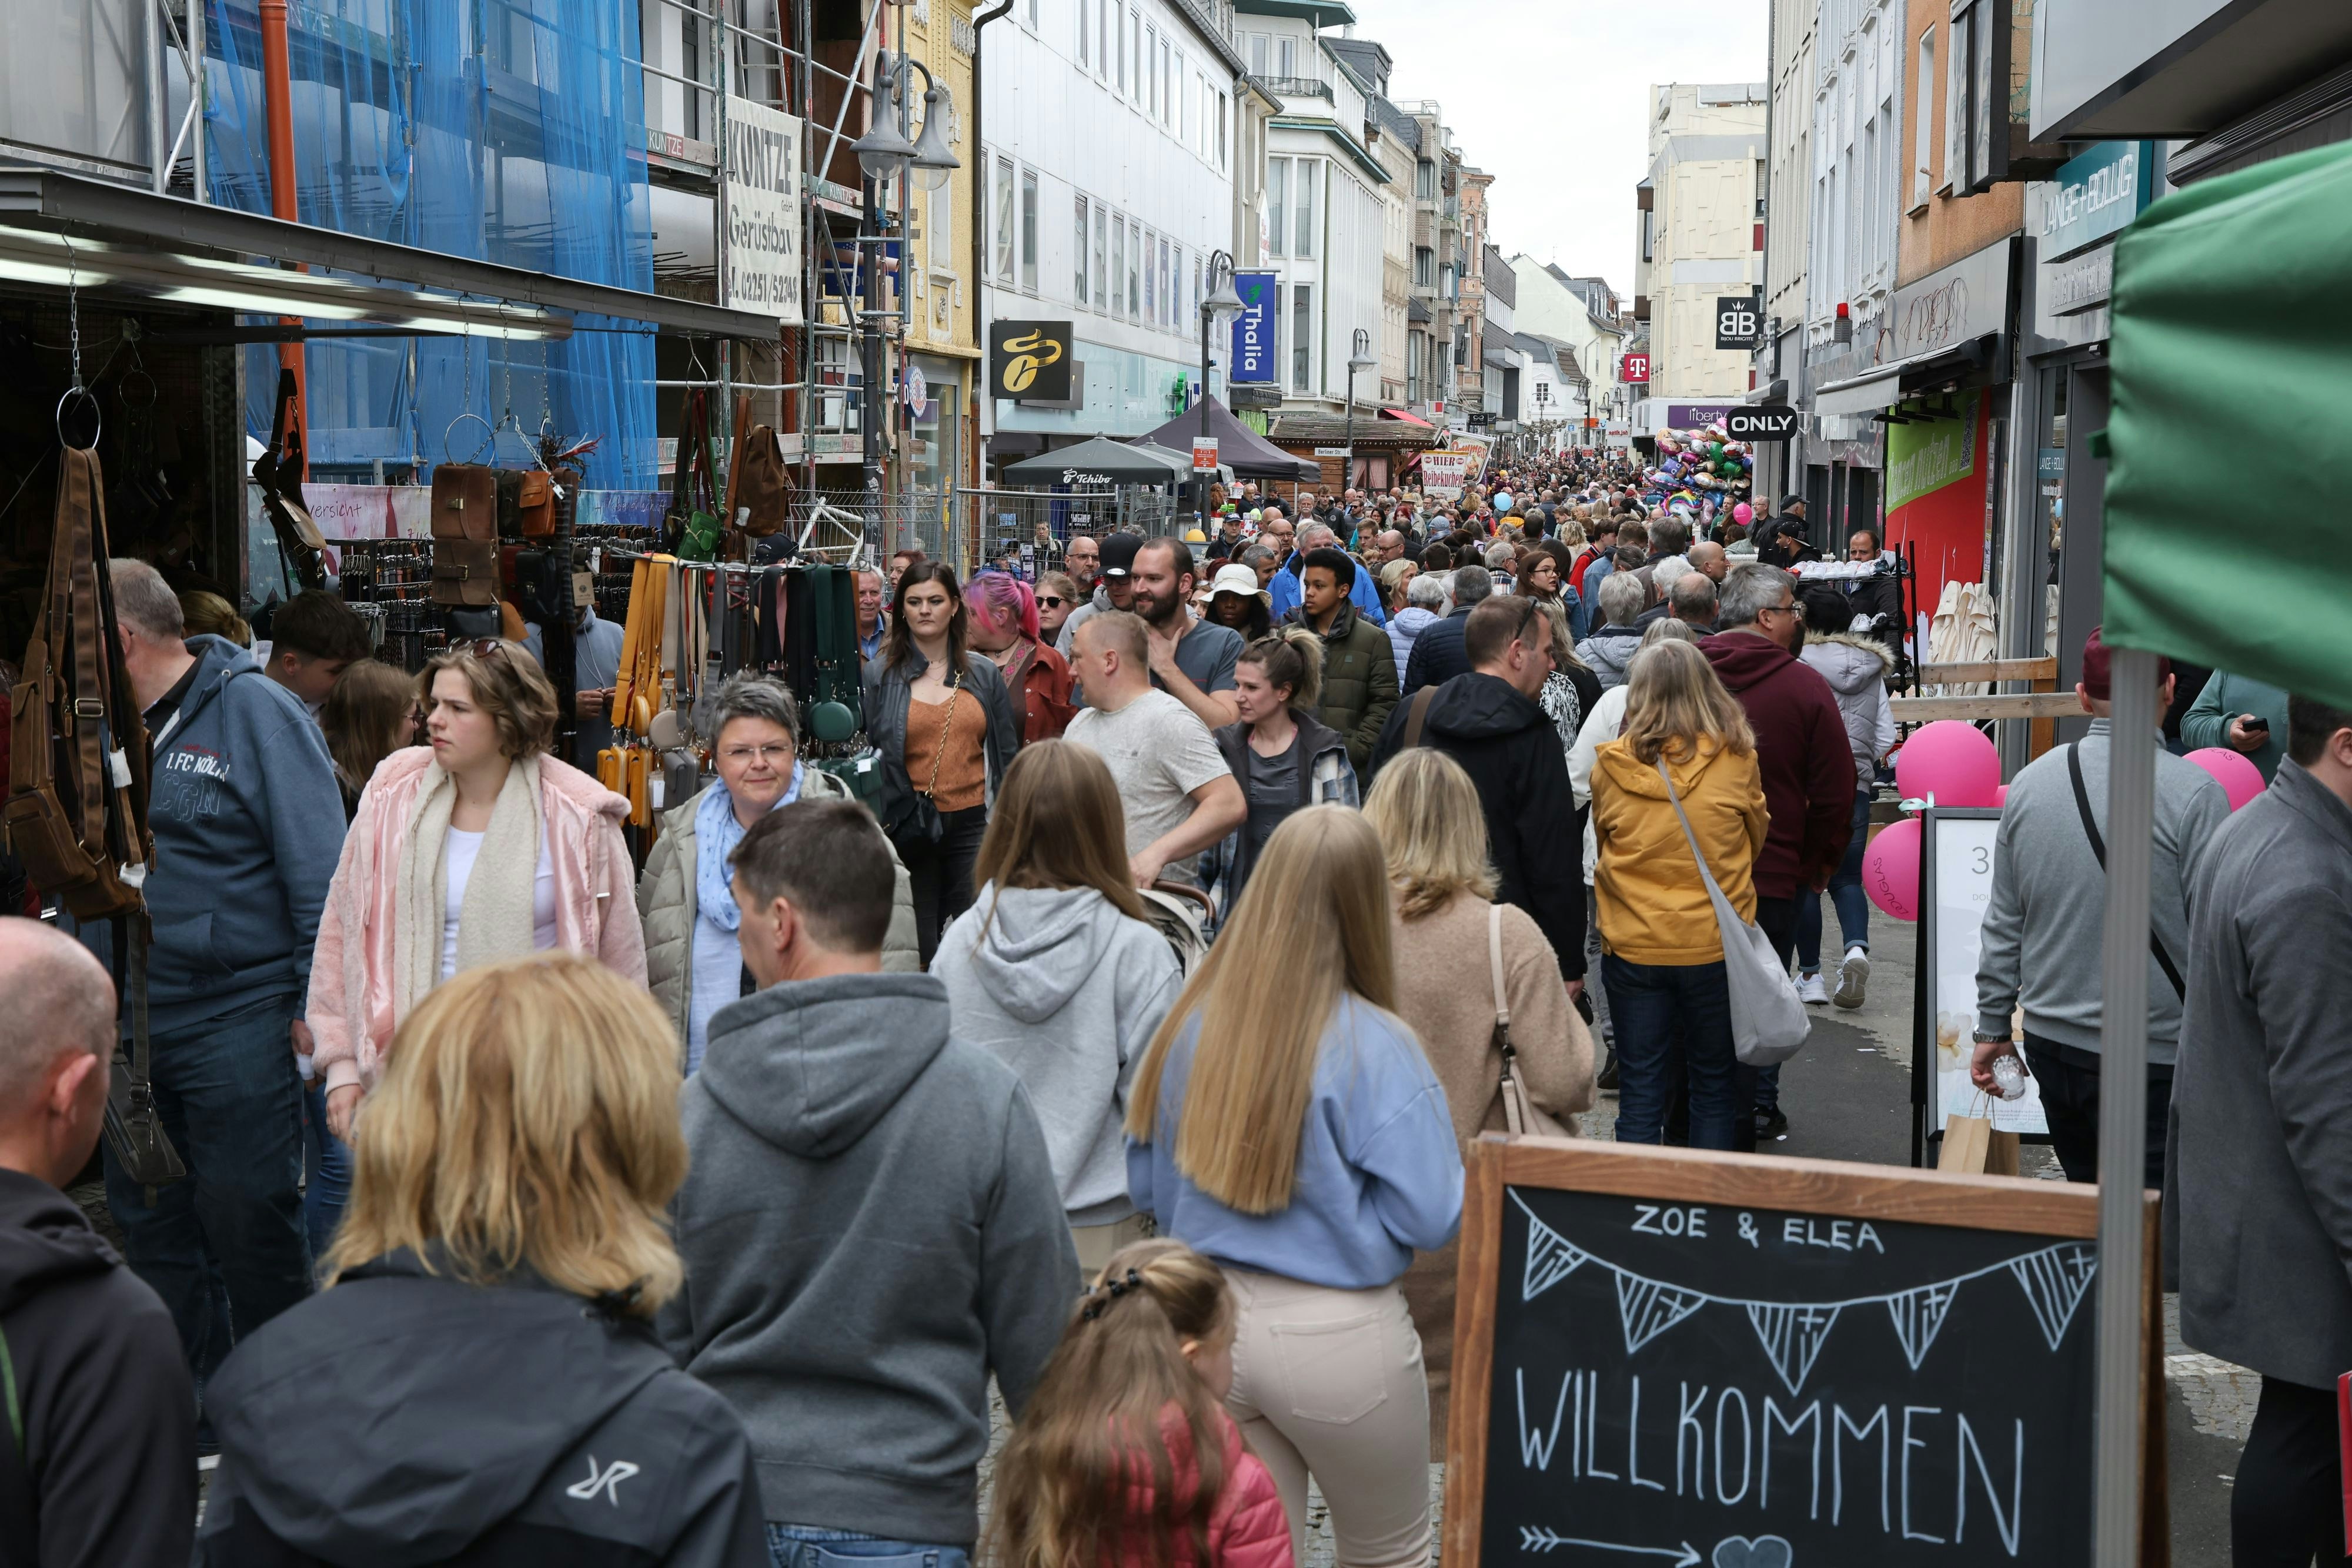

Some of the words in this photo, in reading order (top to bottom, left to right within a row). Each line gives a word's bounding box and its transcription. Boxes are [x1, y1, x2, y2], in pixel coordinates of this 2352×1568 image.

[649, 131, 682, 156] KUNTZE
[727, 118, 791, 195] KUNTZE
[829, 184, 854, 203] KUNTZE
[781, 199, 793, 212] GmbH
[1245, 303, 1262, 371] Thalia
[1689, 407, 1728, 422] liberty
[1731, 416, 1793, 432] ONLY
[1433, 456, 1455, 466] HIER
[1077, 474, 1112, 484] Tchibo
[1424, 470, 1464, 488] Reibekuchen
[193, 755, 230, 782] KÖLN
[1873, 857, 1909, 914] DOUGLAS
[1631, 1204, 1708, 1238] ZOE
[1738, 1212, 1759, 1248] &
[1783, 1218, 1885, 1254] ELEA
[1516, 1367, 2024, 1557] WILLKOMMEN
